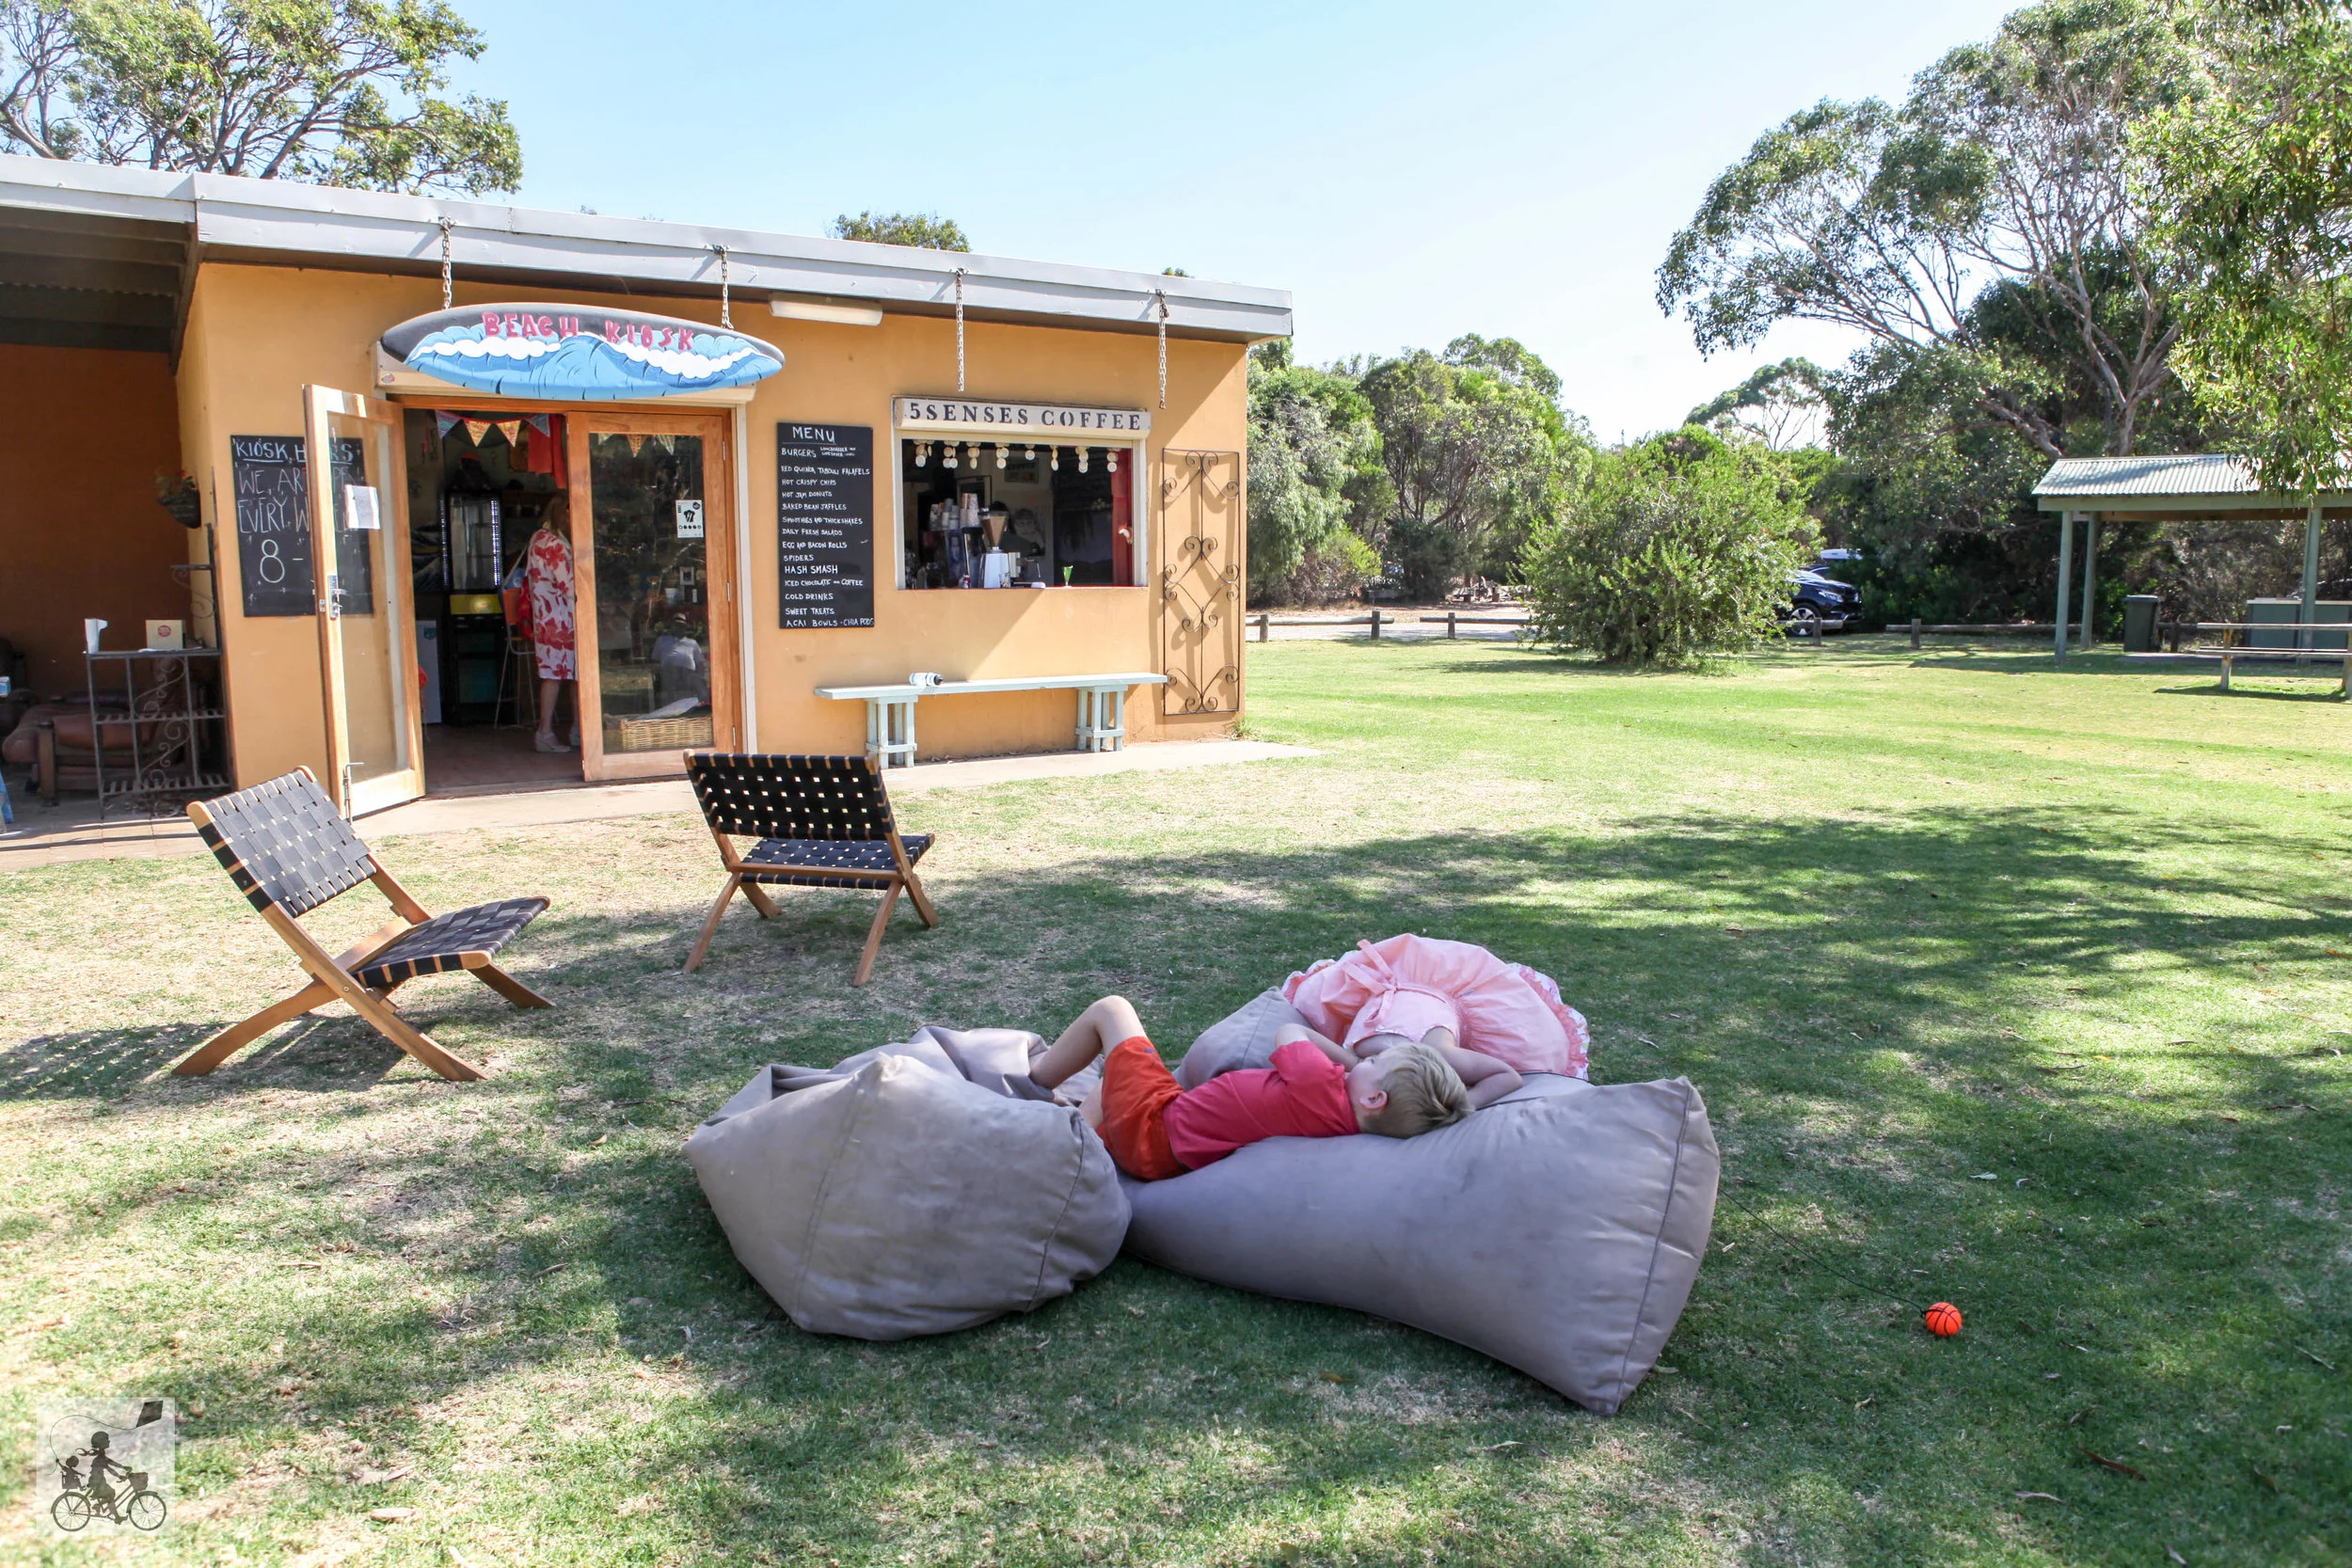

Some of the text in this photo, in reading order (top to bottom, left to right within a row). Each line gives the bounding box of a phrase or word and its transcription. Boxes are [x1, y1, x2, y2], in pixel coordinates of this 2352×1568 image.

[482, 312, 694, 351] BEACH KIOSK
[1041, 410, 1140, 430] COFFEE
[792, 426, 835, 443] MENU
[235, 441, 288, 459] KIOSK
[781, 447, 817, 458] BURGERS
[239, 468, 264, 495] WE
[278, 467, 308, 495] AR
[238, 497, 288, 533] EVERY
[802, 528, 818, 536] FRESH
[782, 541, 794, 549] EGG
[260, 539, 285, 583] 8
[785, 564, 838, 574] HASH SMASH
[805, 593, 834, 601] DRINKS
[810, 607, 835, 615] TREATS
[786, 619, 806, 627] ACAI
[812, 619, 838, 627] BOWLS
